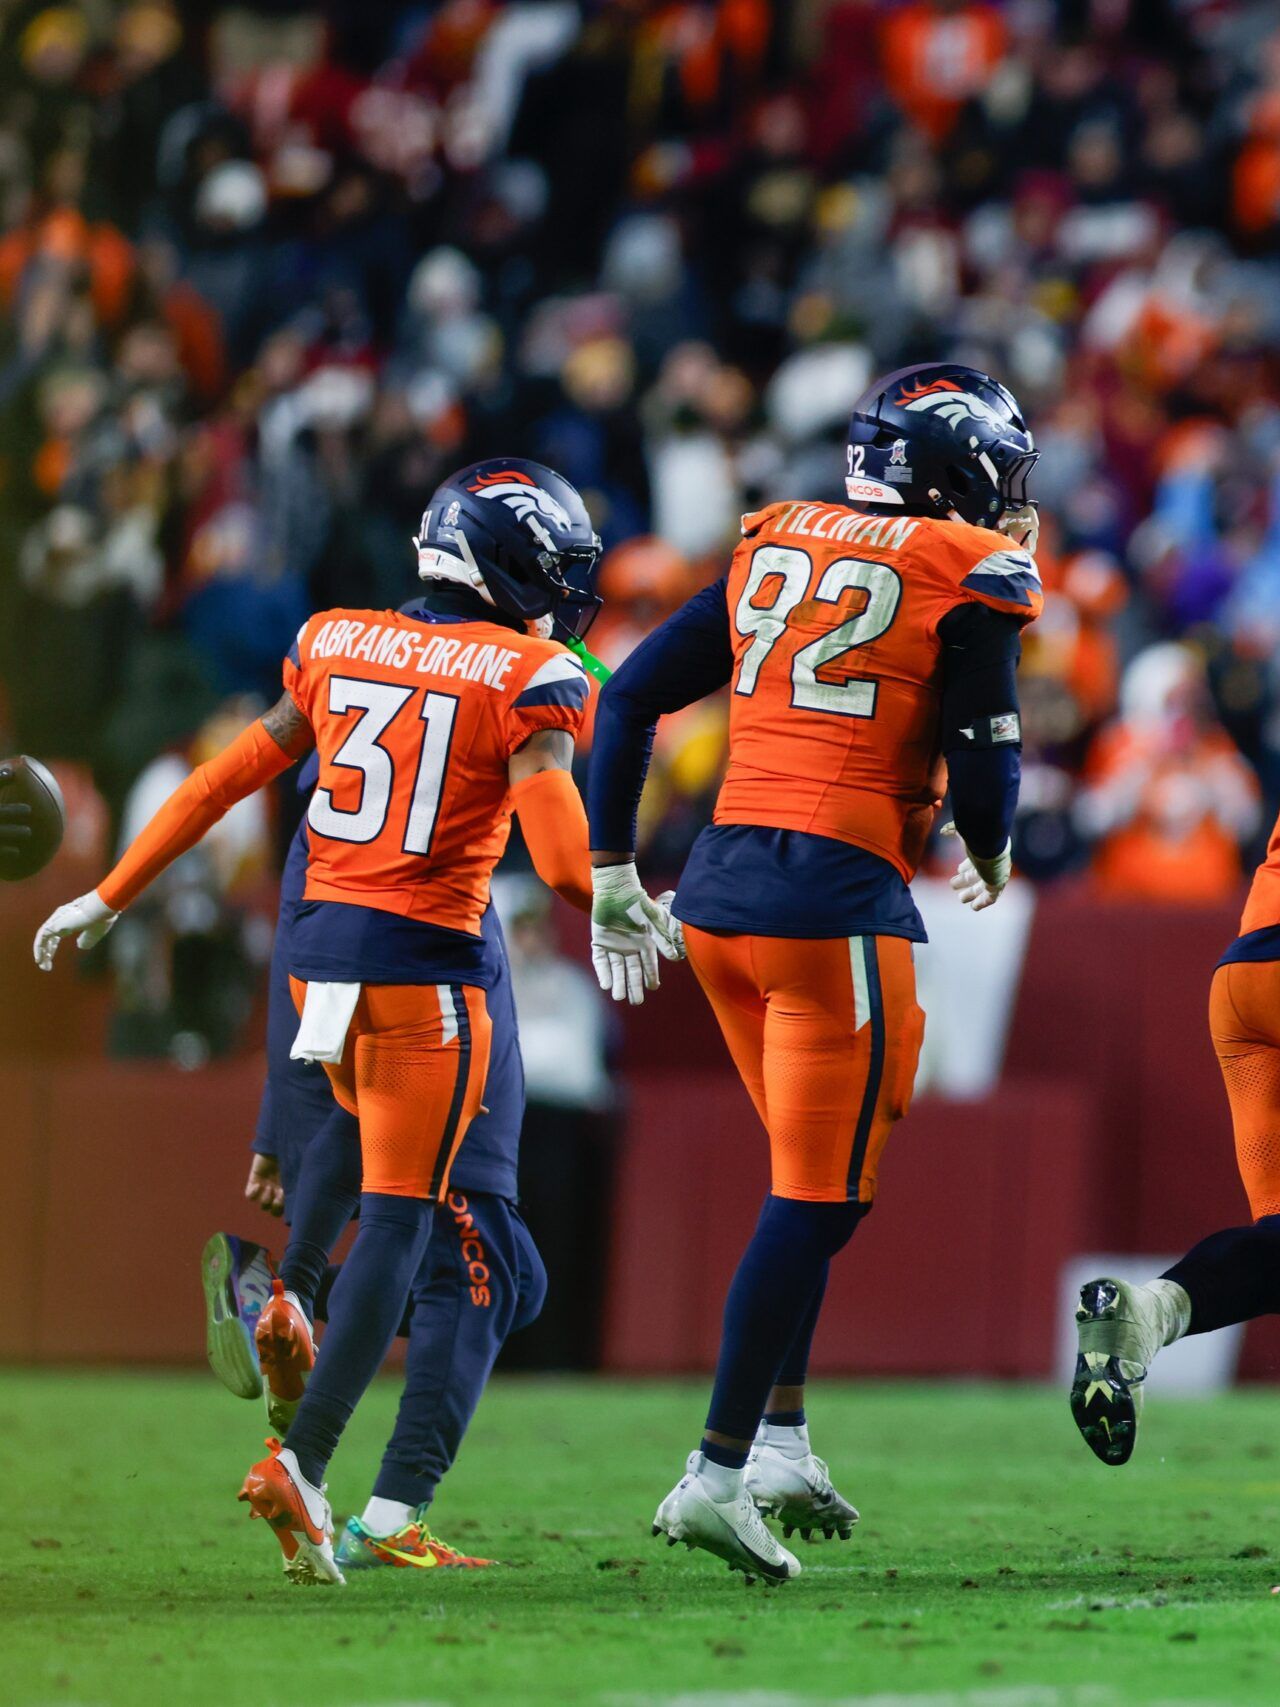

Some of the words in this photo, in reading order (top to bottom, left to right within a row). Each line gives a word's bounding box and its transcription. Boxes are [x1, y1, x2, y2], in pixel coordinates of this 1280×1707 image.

[847, 444, 865, 478] 92
[774, 503, 922, 550] TILLMAN
[310, 619, 521, 691] ABRAMS-DRAINE
[735, 544, 903, 720] 92
[307, 674, 460, 858] 31
